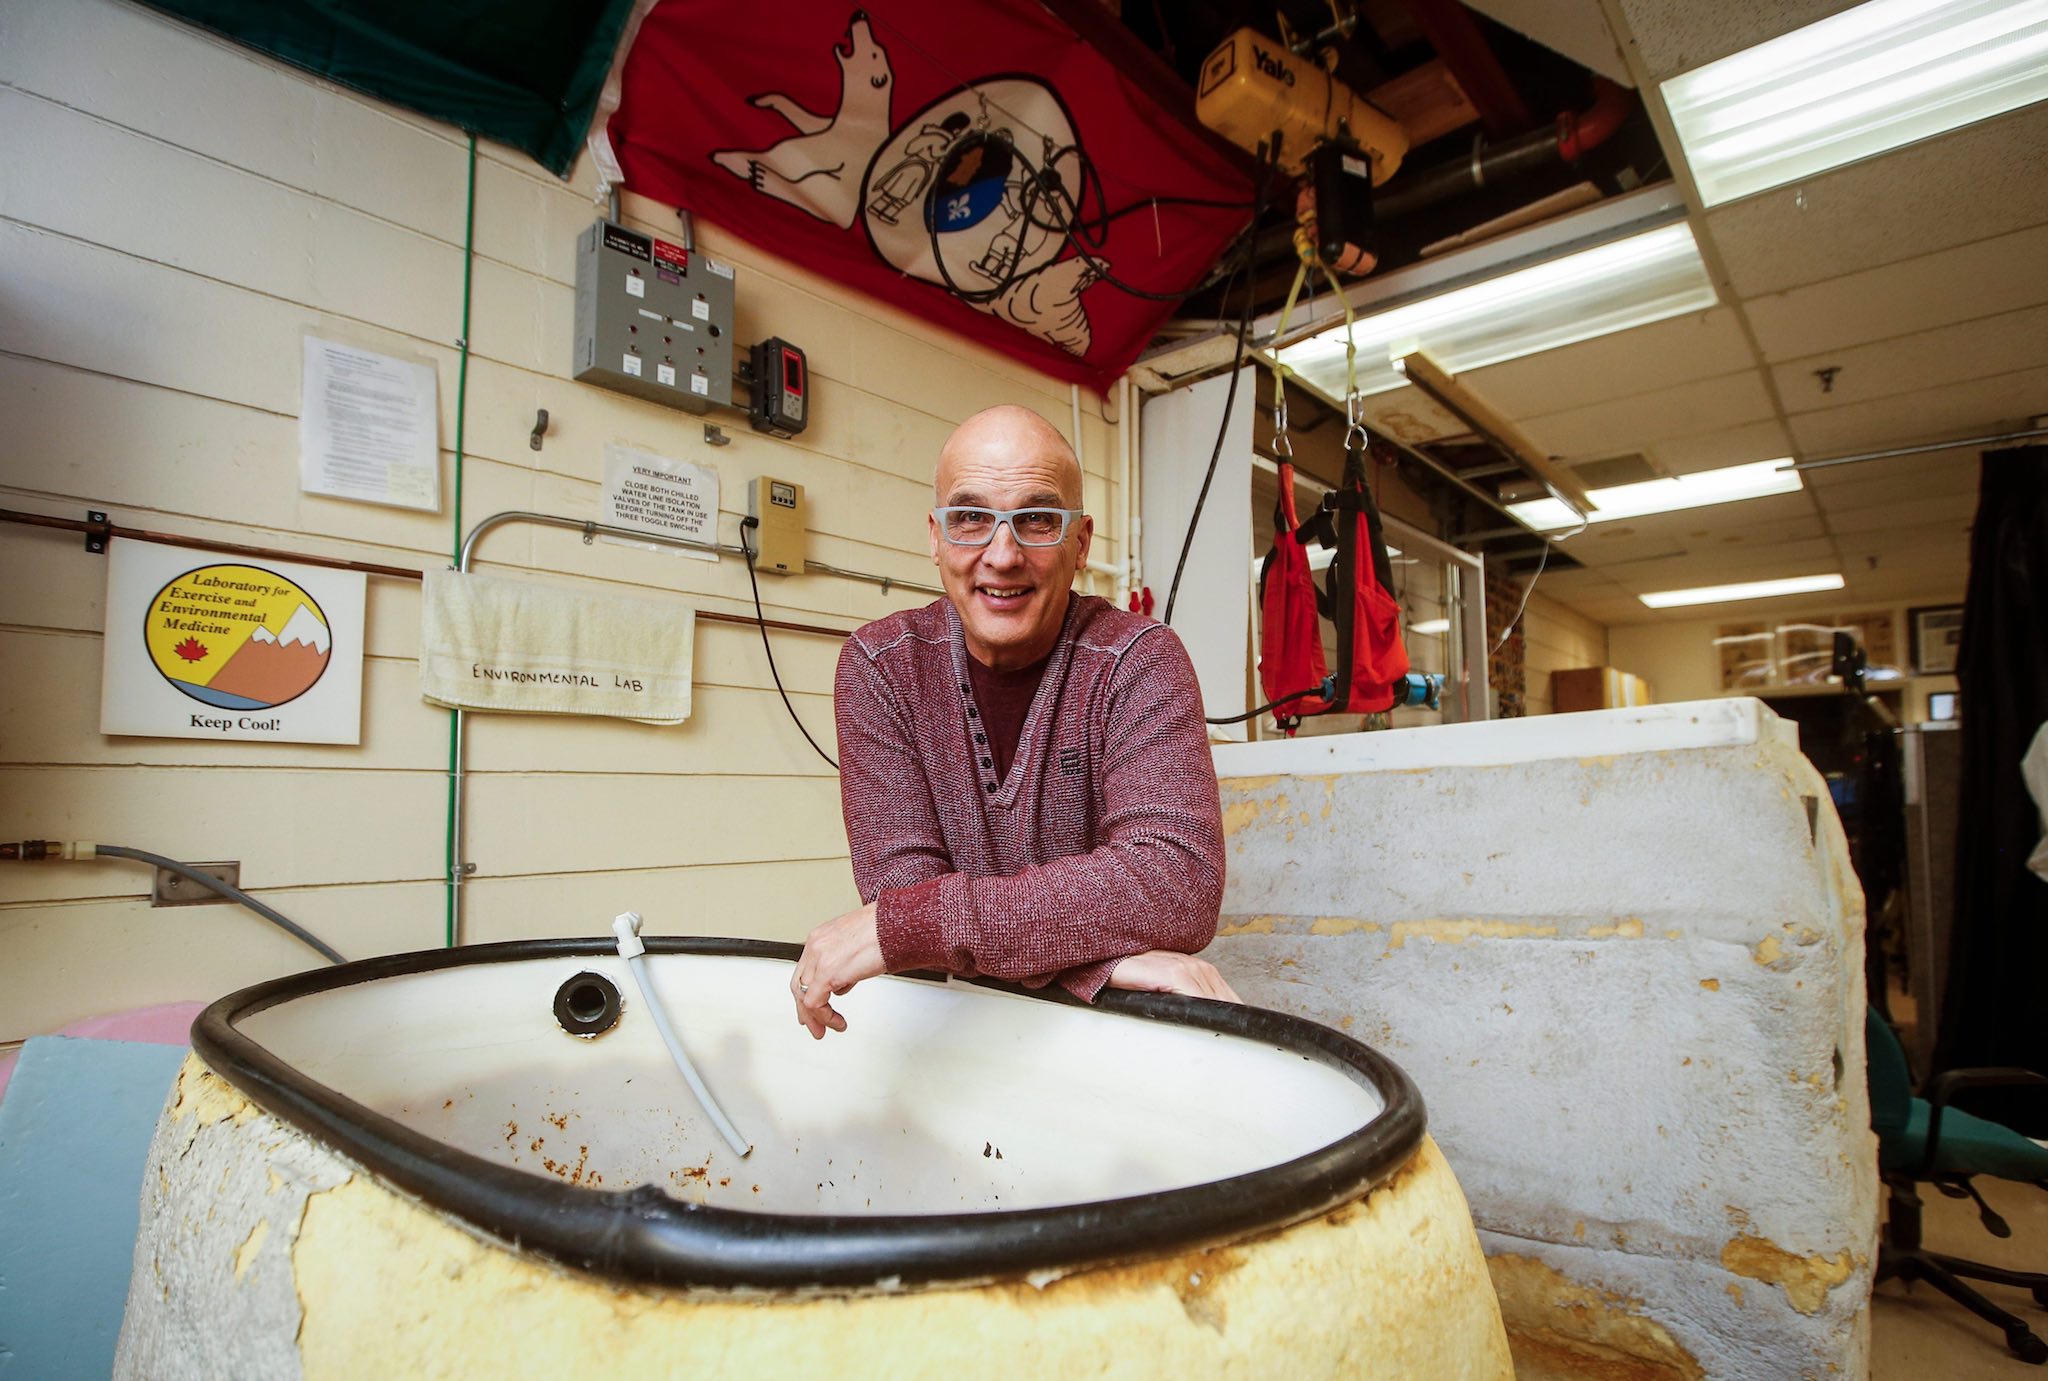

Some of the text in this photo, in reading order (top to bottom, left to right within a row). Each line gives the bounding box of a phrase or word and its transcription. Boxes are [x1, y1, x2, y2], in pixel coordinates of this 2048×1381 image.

[632, 466, 691, 485] VERY IMPORTANT
[622, 488, 700, 510] WATER LINE ISOLATION
[625, 480, 699, 501] CLOSE BOTH CHILLED
[613, 494, 640, 505] VALVES
[653, 502, 666, 510] THE
[668, 506, 686, 515] TANK
[695, 511, 708, 519] USE
[616, 503, 703, 526] BEFORE TURNING OFF THE
[616, 511, 699, 533] THREE TOGGLE SWICHES
[192, 574, 291, 597] Laboratory for
[170, 587, 257, 608] Exercise and
[159, 601, 267, 623] Environmental
[163, 617, 231, 635] Medicine
[472, 663, 644, 692] ENVIRONMENTAL LAB
[190, 714, 281, 731] Keep Cool!
